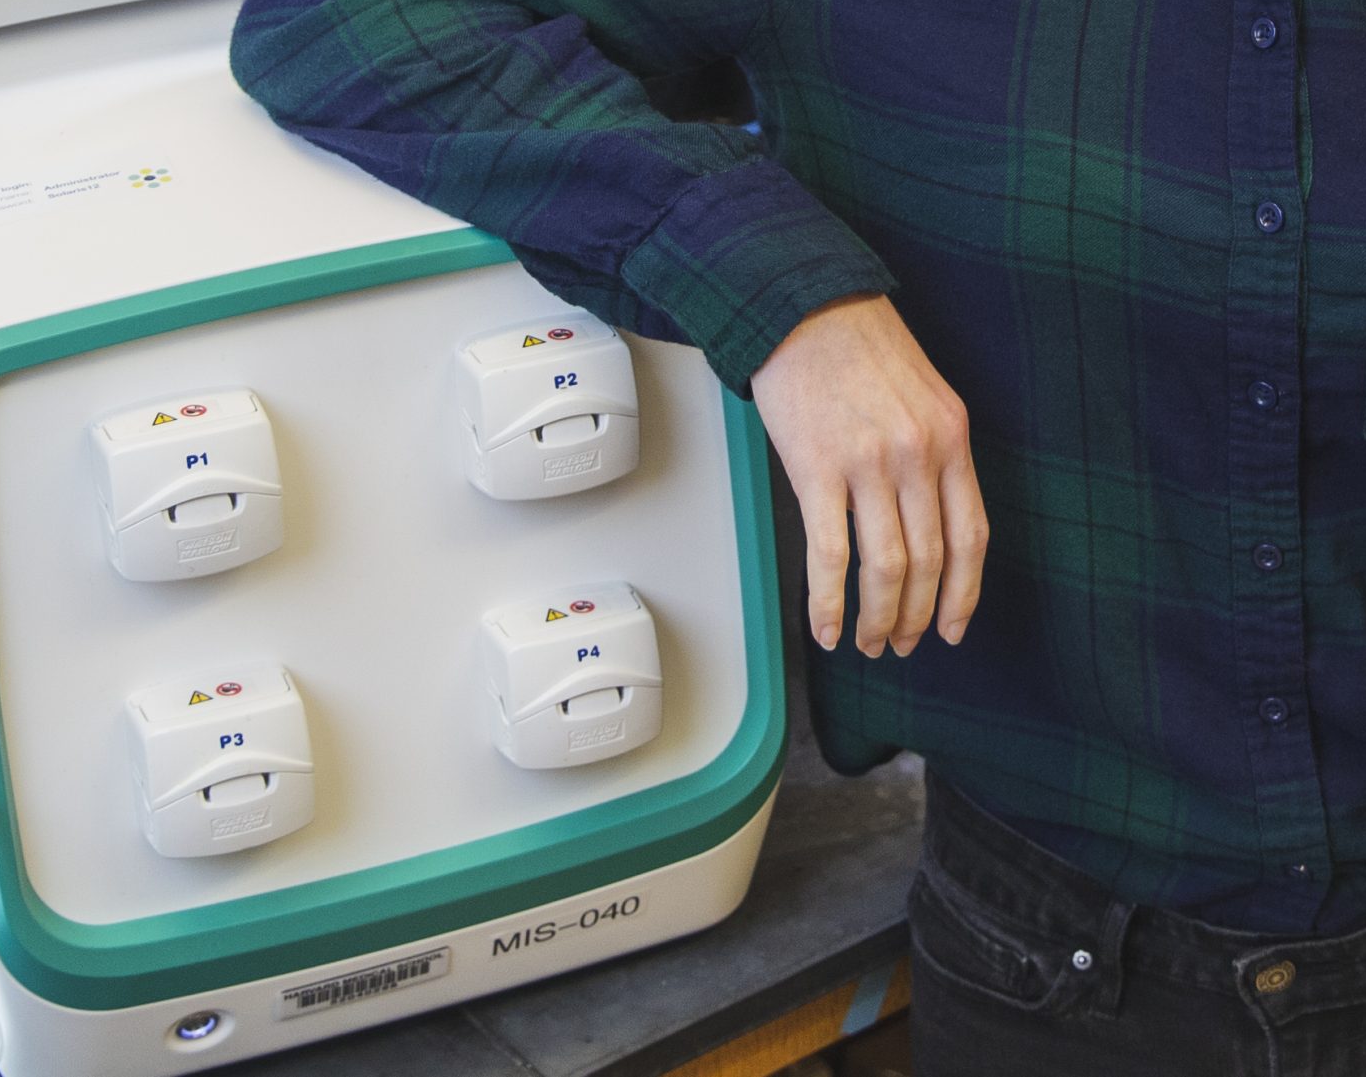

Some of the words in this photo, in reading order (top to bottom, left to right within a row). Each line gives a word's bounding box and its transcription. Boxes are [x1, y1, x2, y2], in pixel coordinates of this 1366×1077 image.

[44, 171, 121, 191] Administrator
[554, 373, 578, 390] P2
[186, 452, 208, 469] P1
[577, 644, 600, 662] P4
[220, 733, 244, 749] P3
[492, 895, 640, 957] MIS-040
